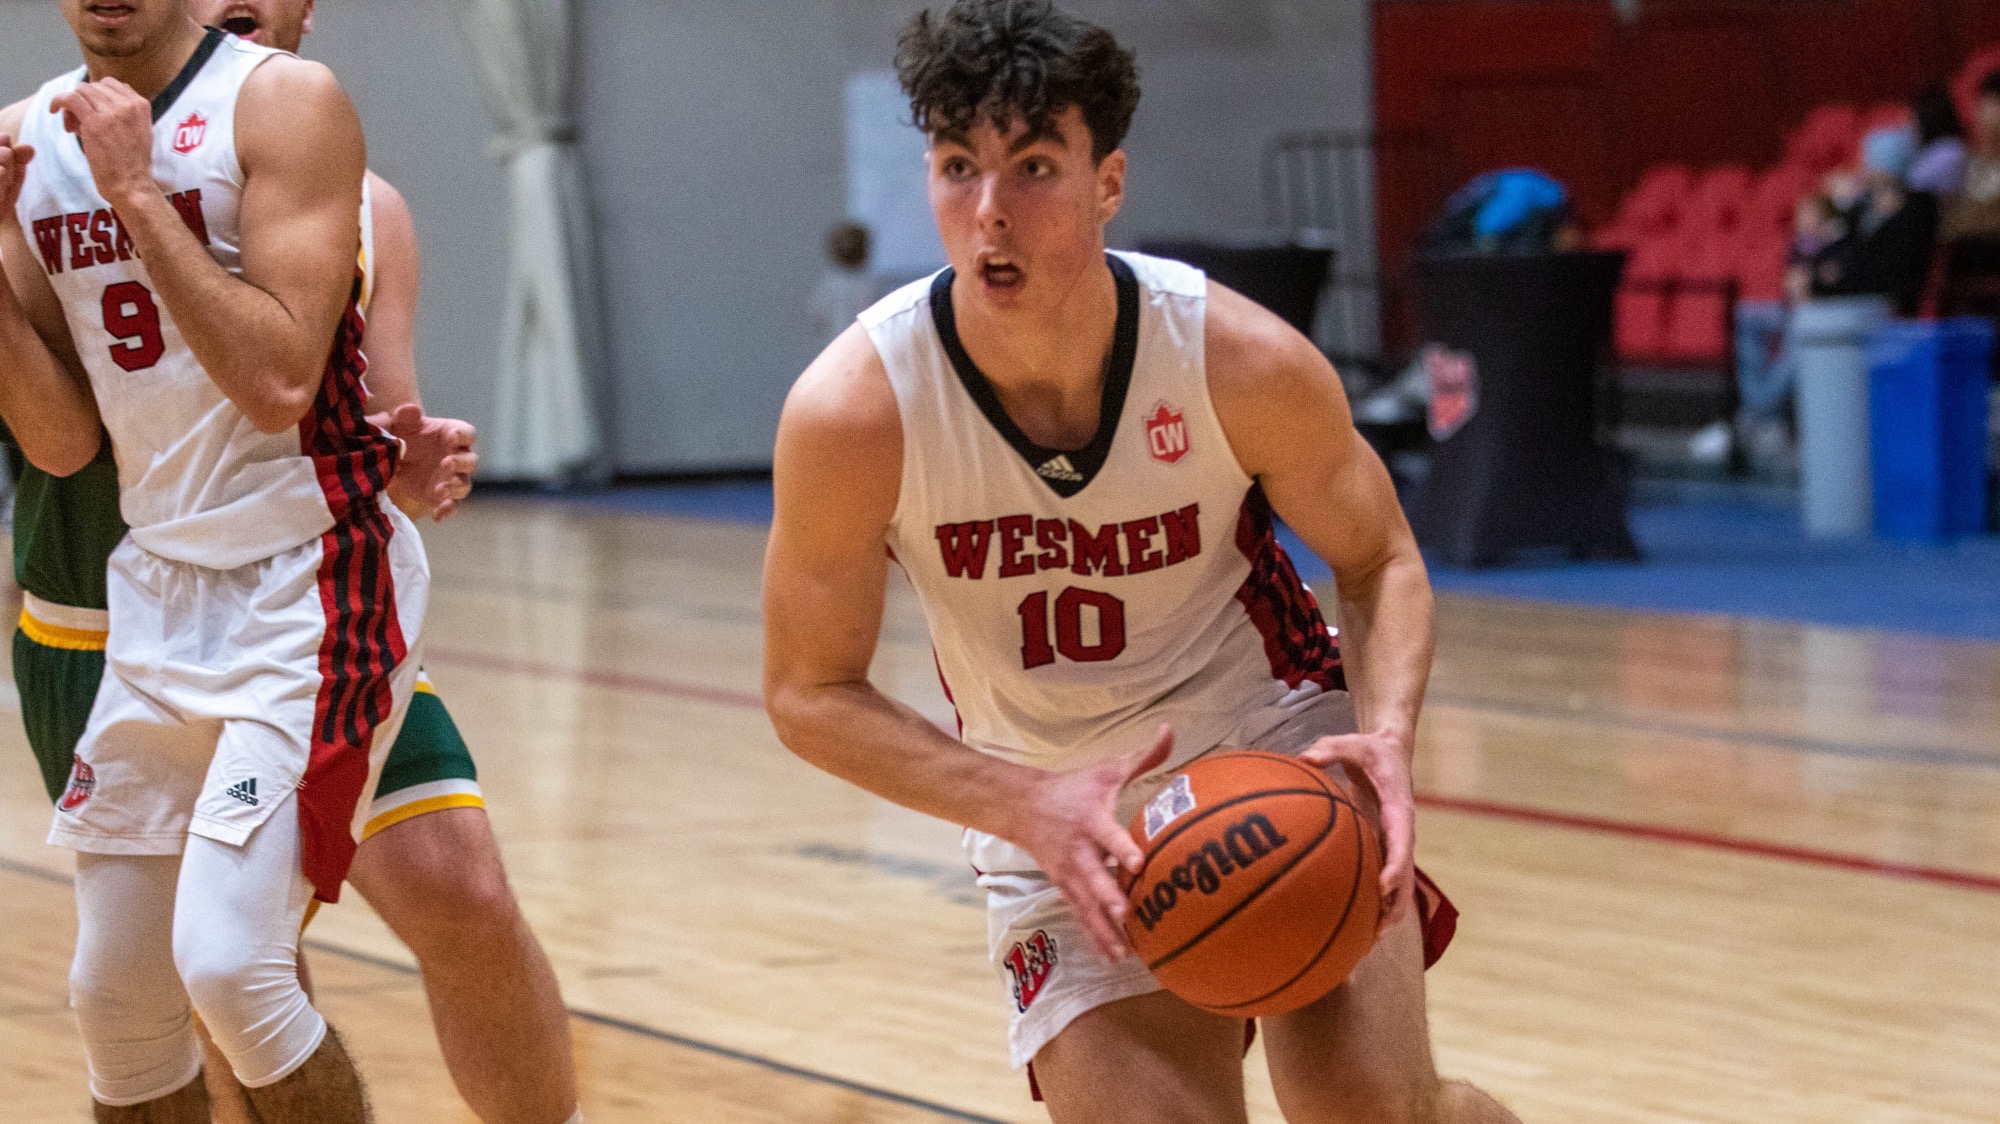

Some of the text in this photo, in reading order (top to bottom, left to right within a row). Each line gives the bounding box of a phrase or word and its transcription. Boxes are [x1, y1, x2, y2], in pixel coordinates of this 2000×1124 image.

[175, 125, 205, 149] CW
[32, 188, 211, 276] WESN
[101, 280, 166, 373] 9
[1149, 421, 1185, 457] CW
[935, 502, 1202, 581] WESMEN
[1016, 584, 1127, 671] 10
[226, 788, 260, 807] adidas
[1134, 812, 1289, 932] Wilson
